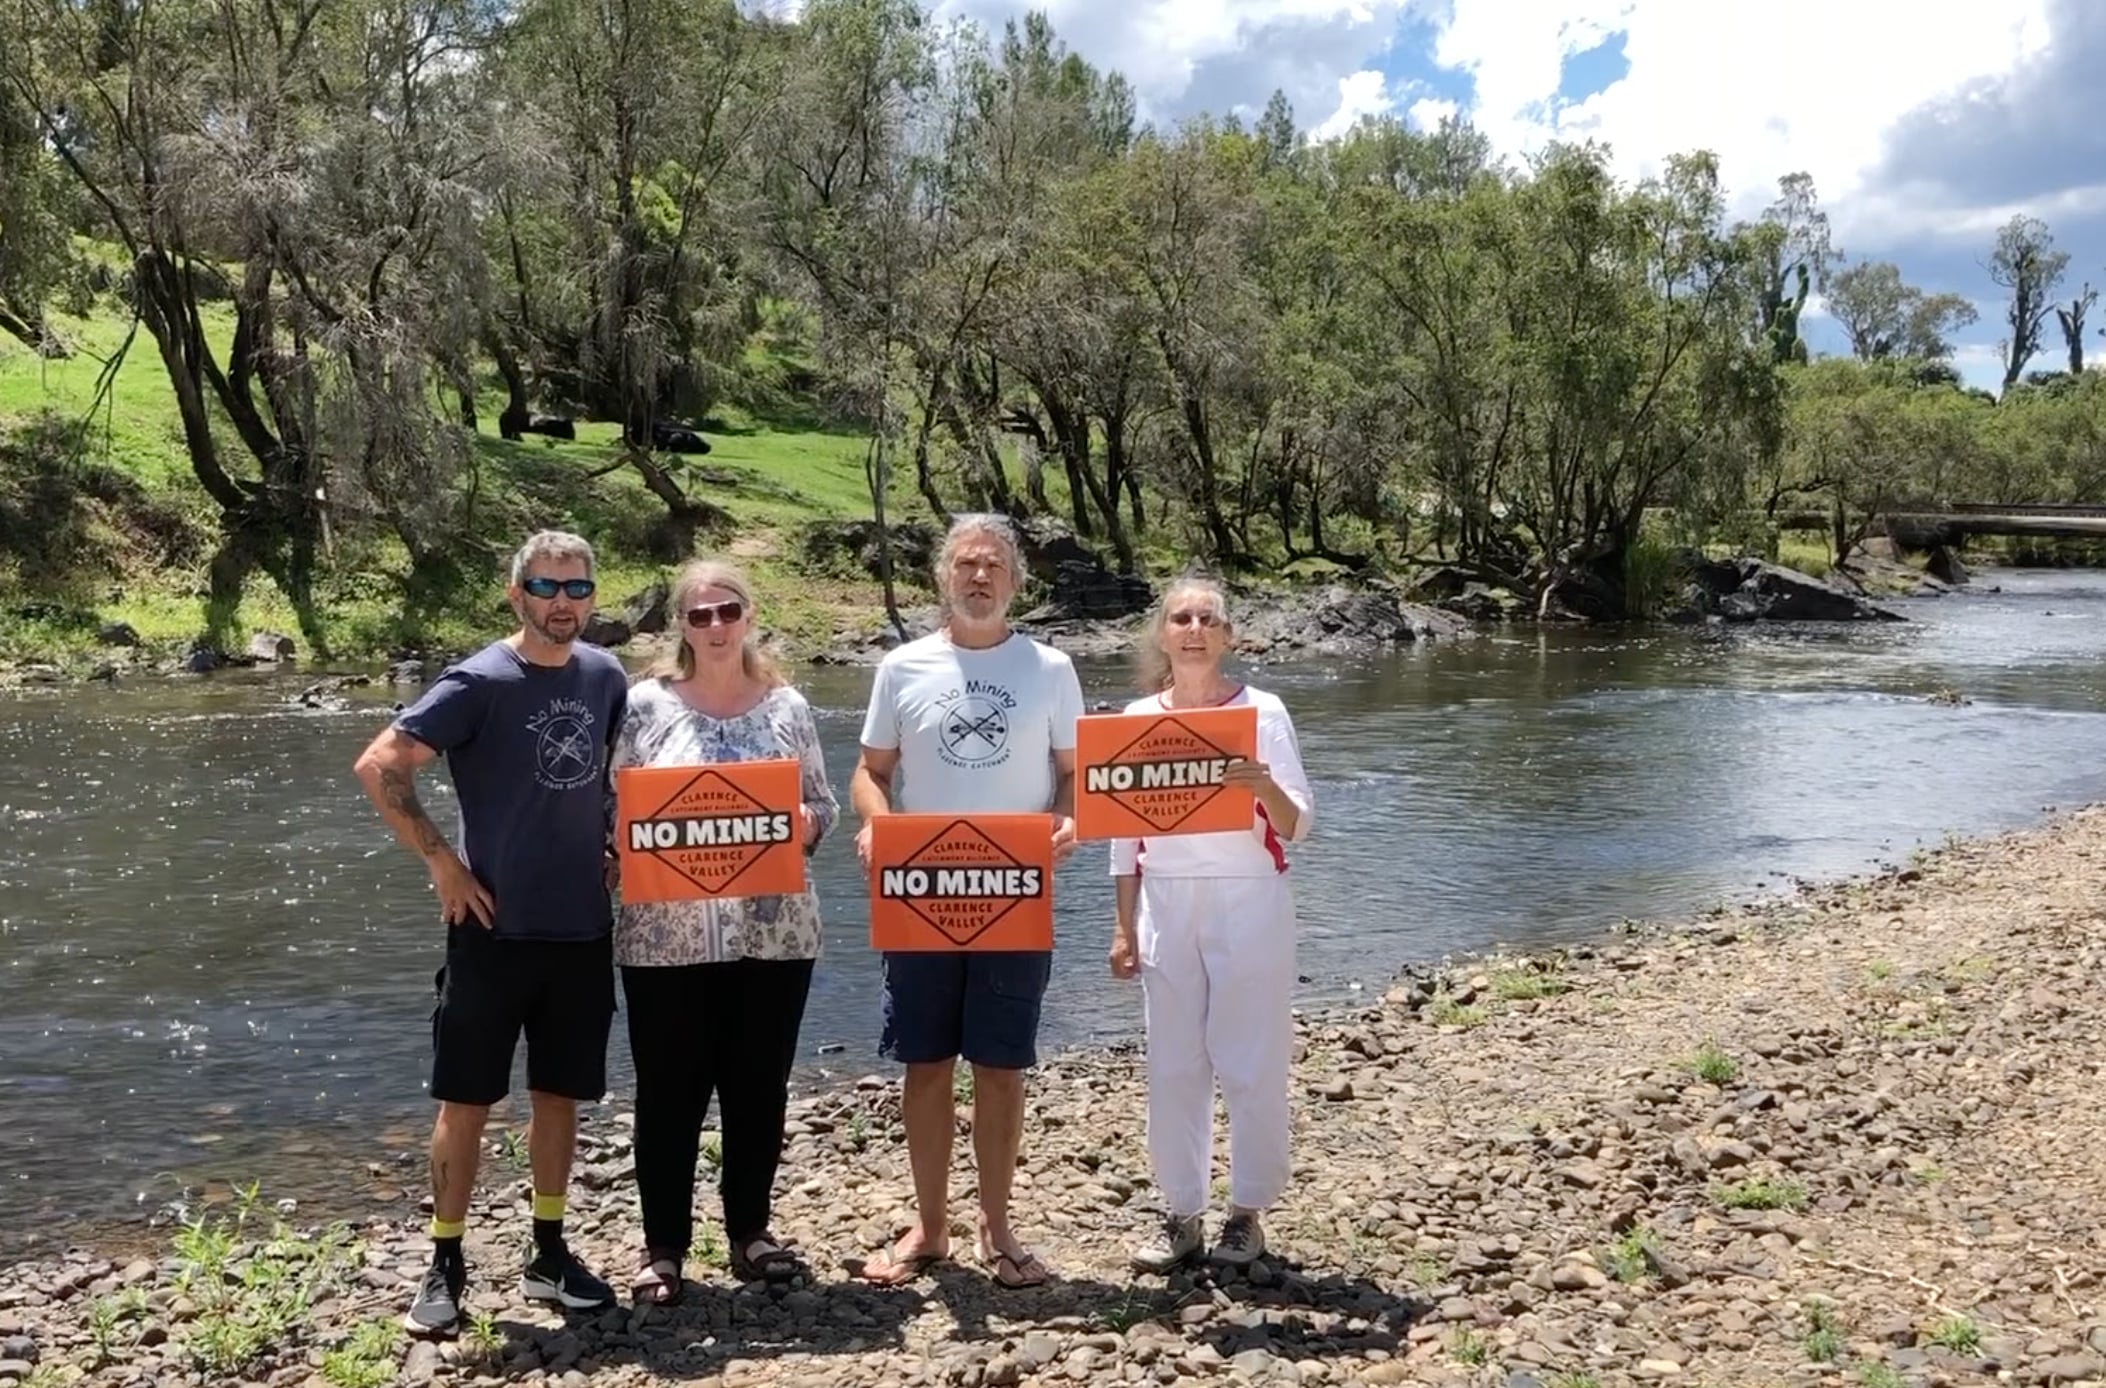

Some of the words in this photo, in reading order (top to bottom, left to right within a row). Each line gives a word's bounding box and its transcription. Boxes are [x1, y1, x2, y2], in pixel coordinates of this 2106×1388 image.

[934, 688, 960, 709] No
[965, 679, 1017, 709] Mining
[525, 710, 548, 733] No
[550, 697, 595, 726] Mining
[1139, 737, 1196, 750] CLARENCE
[1087, 765, 1134, 792] NO
[1141, 757, 1246, 789] MINE
[681, 791, 739, 805] CLARENCE
[1133, 791, 1198, 804] CLARENCE
[1143, 804, 1189, 817] VALLEY
[631, 821, 678, 850] NO
[686, 814, 790, 846] MINES
[933, 842, 990, 854] CLARENCE
[679, 850, 744, 864] CLARENCE
[689, 863, 736, 877] VALLEY
[883, 869, 929, 896] NO
[937, 869, 1040, 896] MINES
[929, 902, 993, 913] CLARENCE
[938, 915, 985, 928] VALLEY
